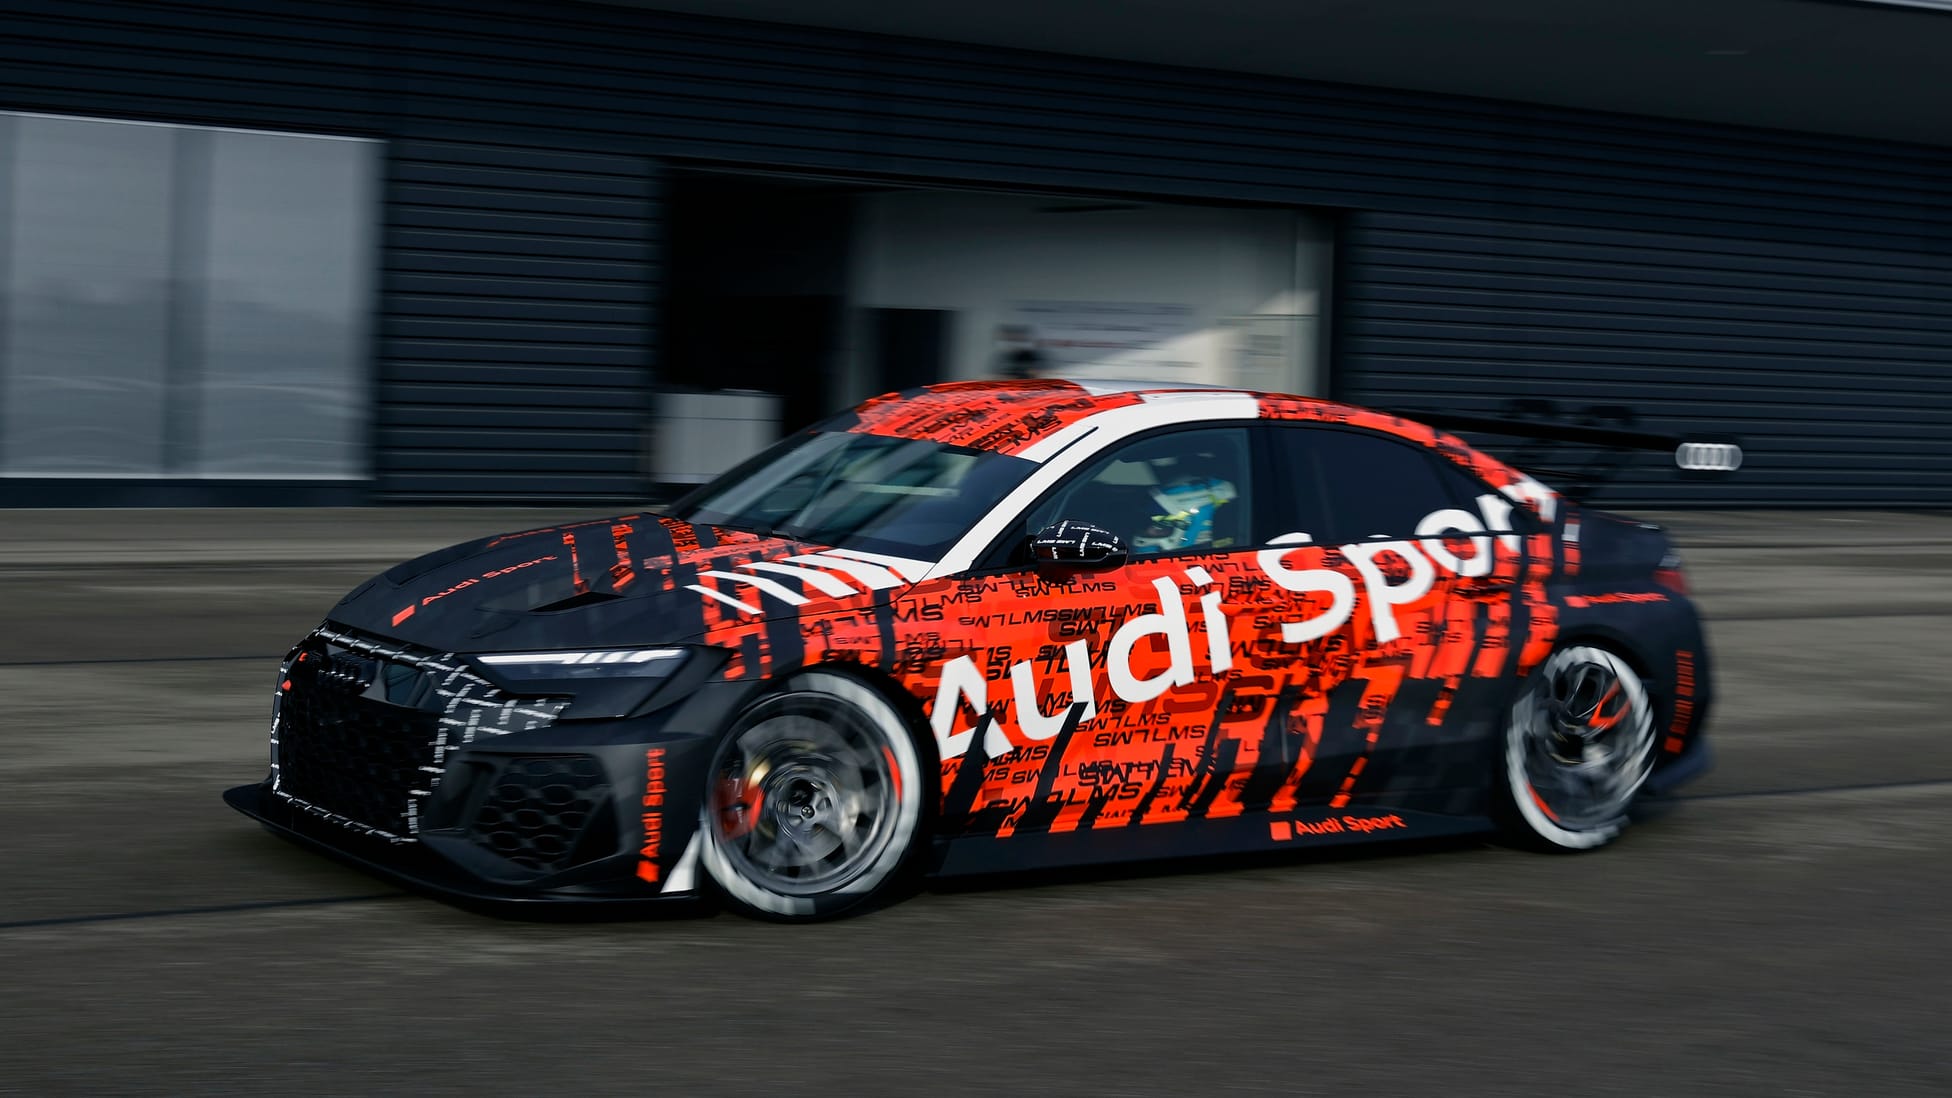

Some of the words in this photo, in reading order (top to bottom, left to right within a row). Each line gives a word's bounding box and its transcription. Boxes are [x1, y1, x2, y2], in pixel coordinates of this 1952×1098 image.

[422, 578, 480, 606] Audi
[481, 555, 558, 578] Sport
[930, 565, 1233, 760] Audi
[642, 748, 668, 807] Sport
[640, 812, 662, 858] Audi
[1295, 817, 1346, 835] Audi
[1341, 814, 1408, 834] Sport
